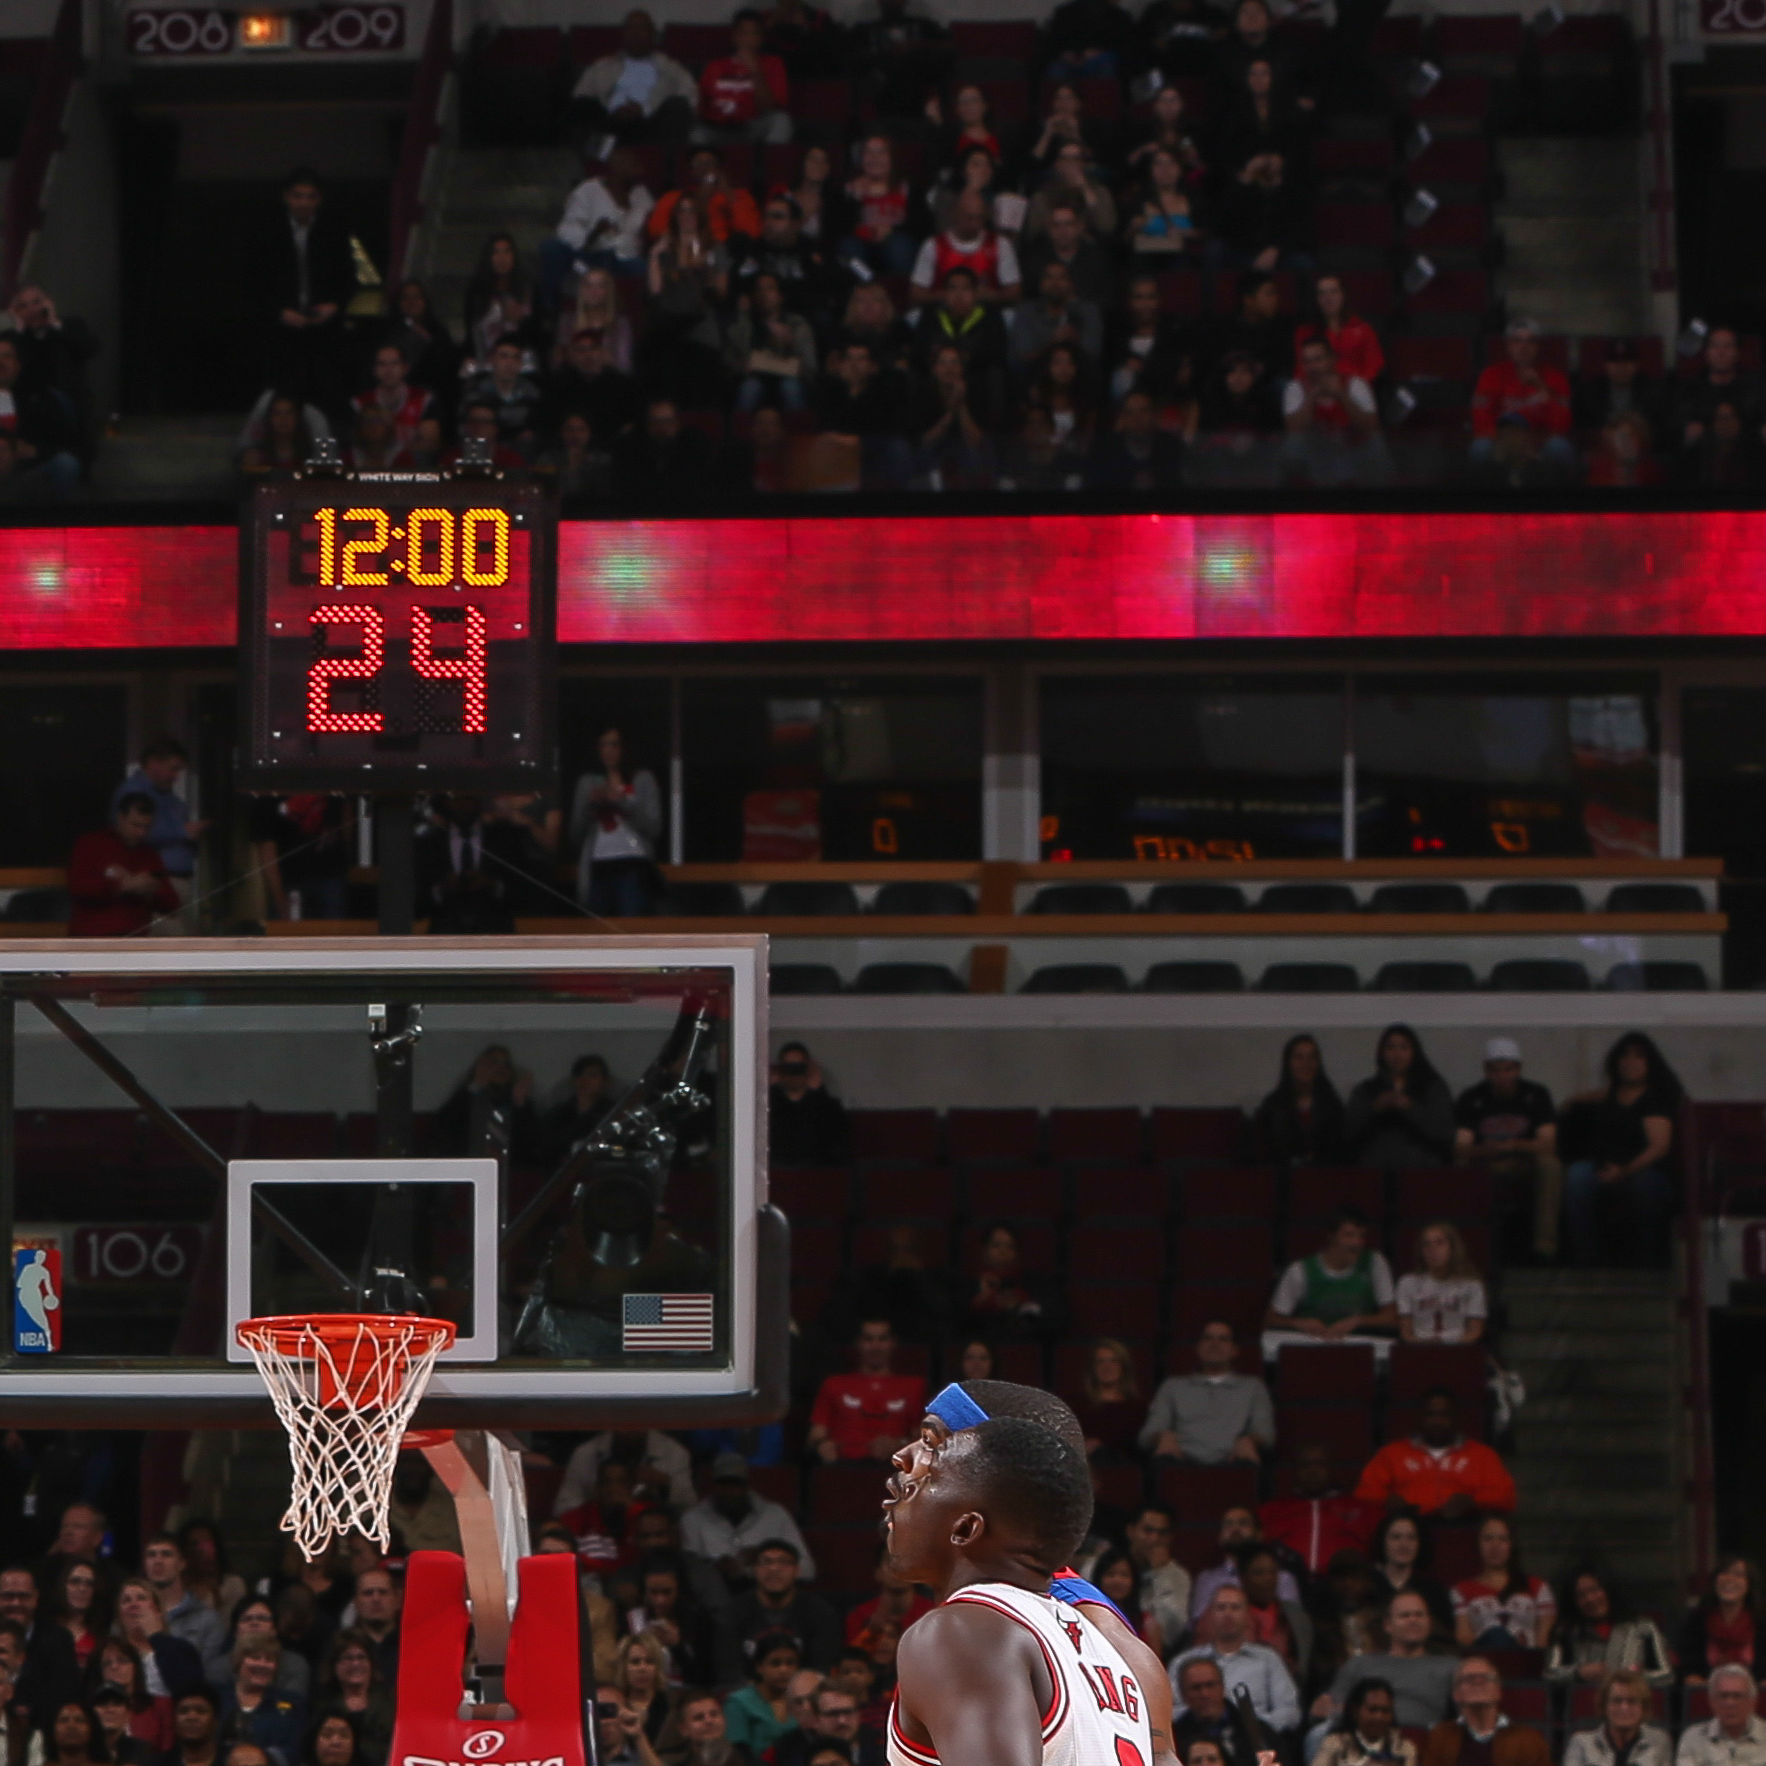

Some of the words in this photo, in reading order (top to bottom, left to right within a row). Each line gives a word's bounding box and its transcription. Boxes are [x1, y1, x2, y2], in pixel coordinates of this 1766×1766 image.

[133, 12, 230, 53] 208
[306, 9, 399, 51] 209
[313, 507, 511, 587] 12:00
[307, 604, 488, 733] 24
[86, 1231, 187, 1279] 106
[19, 1332, 45, 1347] NBA
